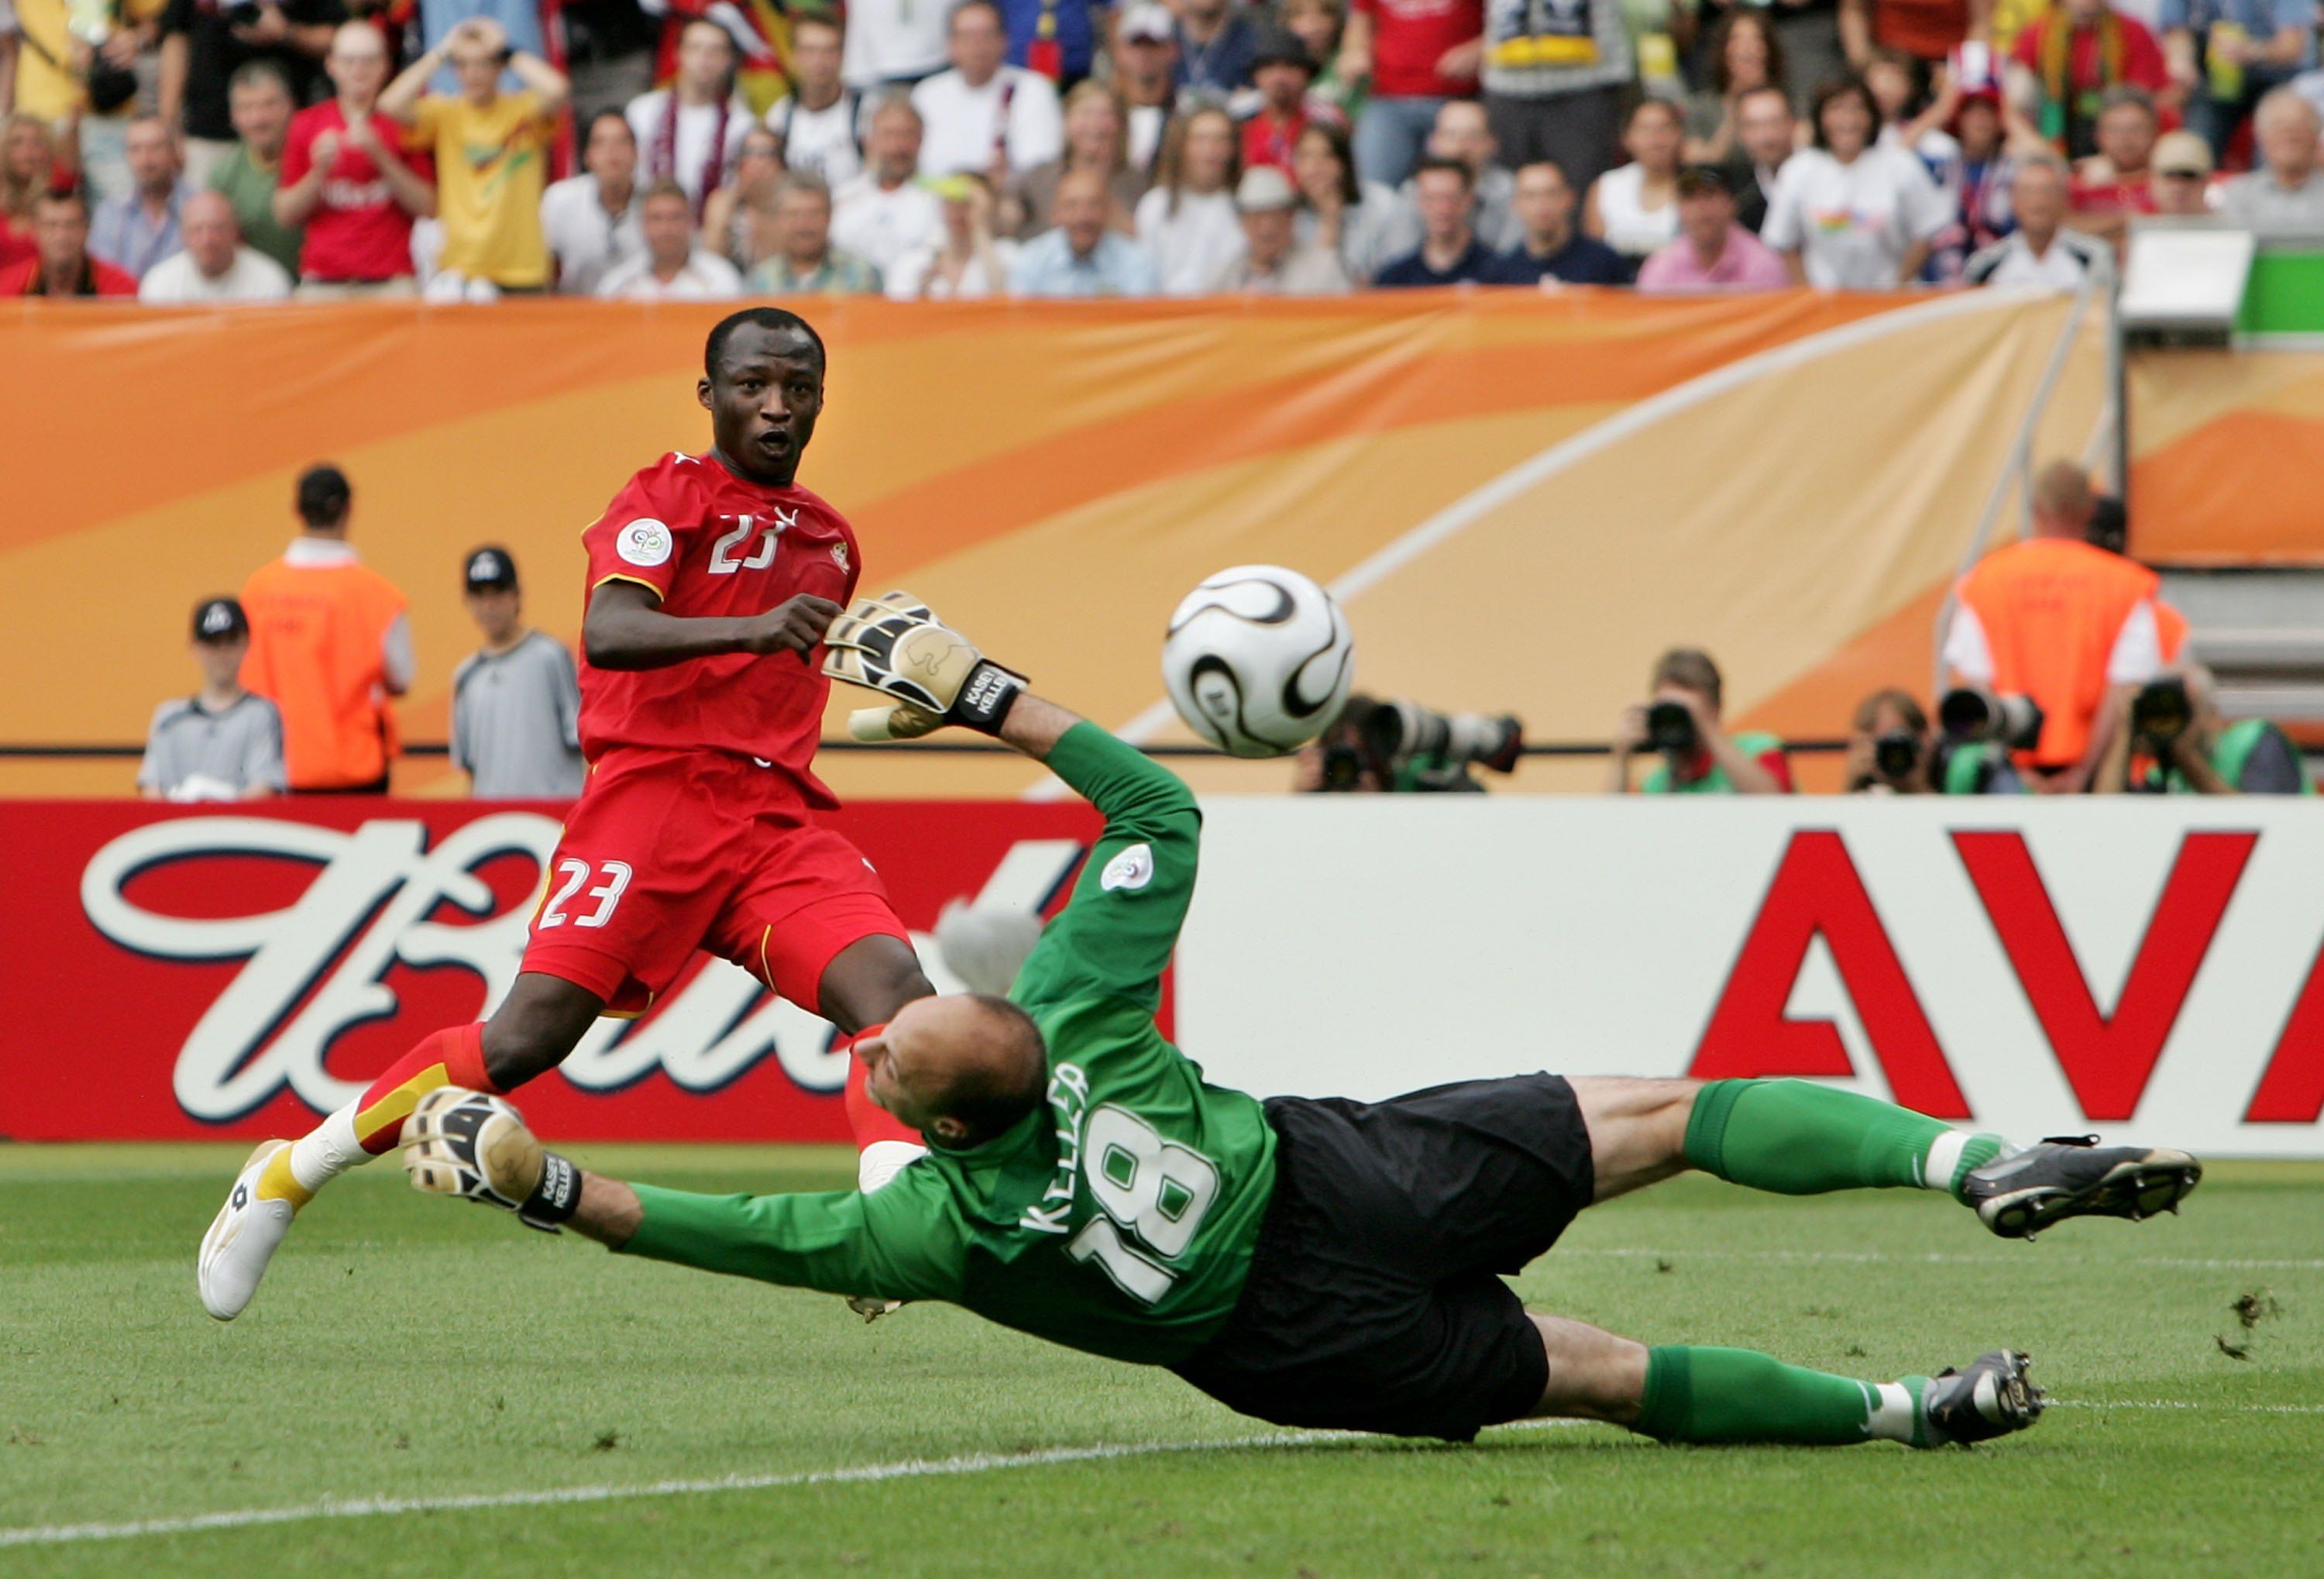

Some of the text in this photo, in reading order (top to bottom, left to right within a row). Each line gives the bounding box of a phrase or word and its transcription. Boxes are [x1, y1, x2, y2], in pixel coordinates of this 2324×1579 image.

[538, 858, 633, 930] 23
[1019, 1062, 1089, 1233] KELLER
[1060, 1100, 1221, 1309] 18
